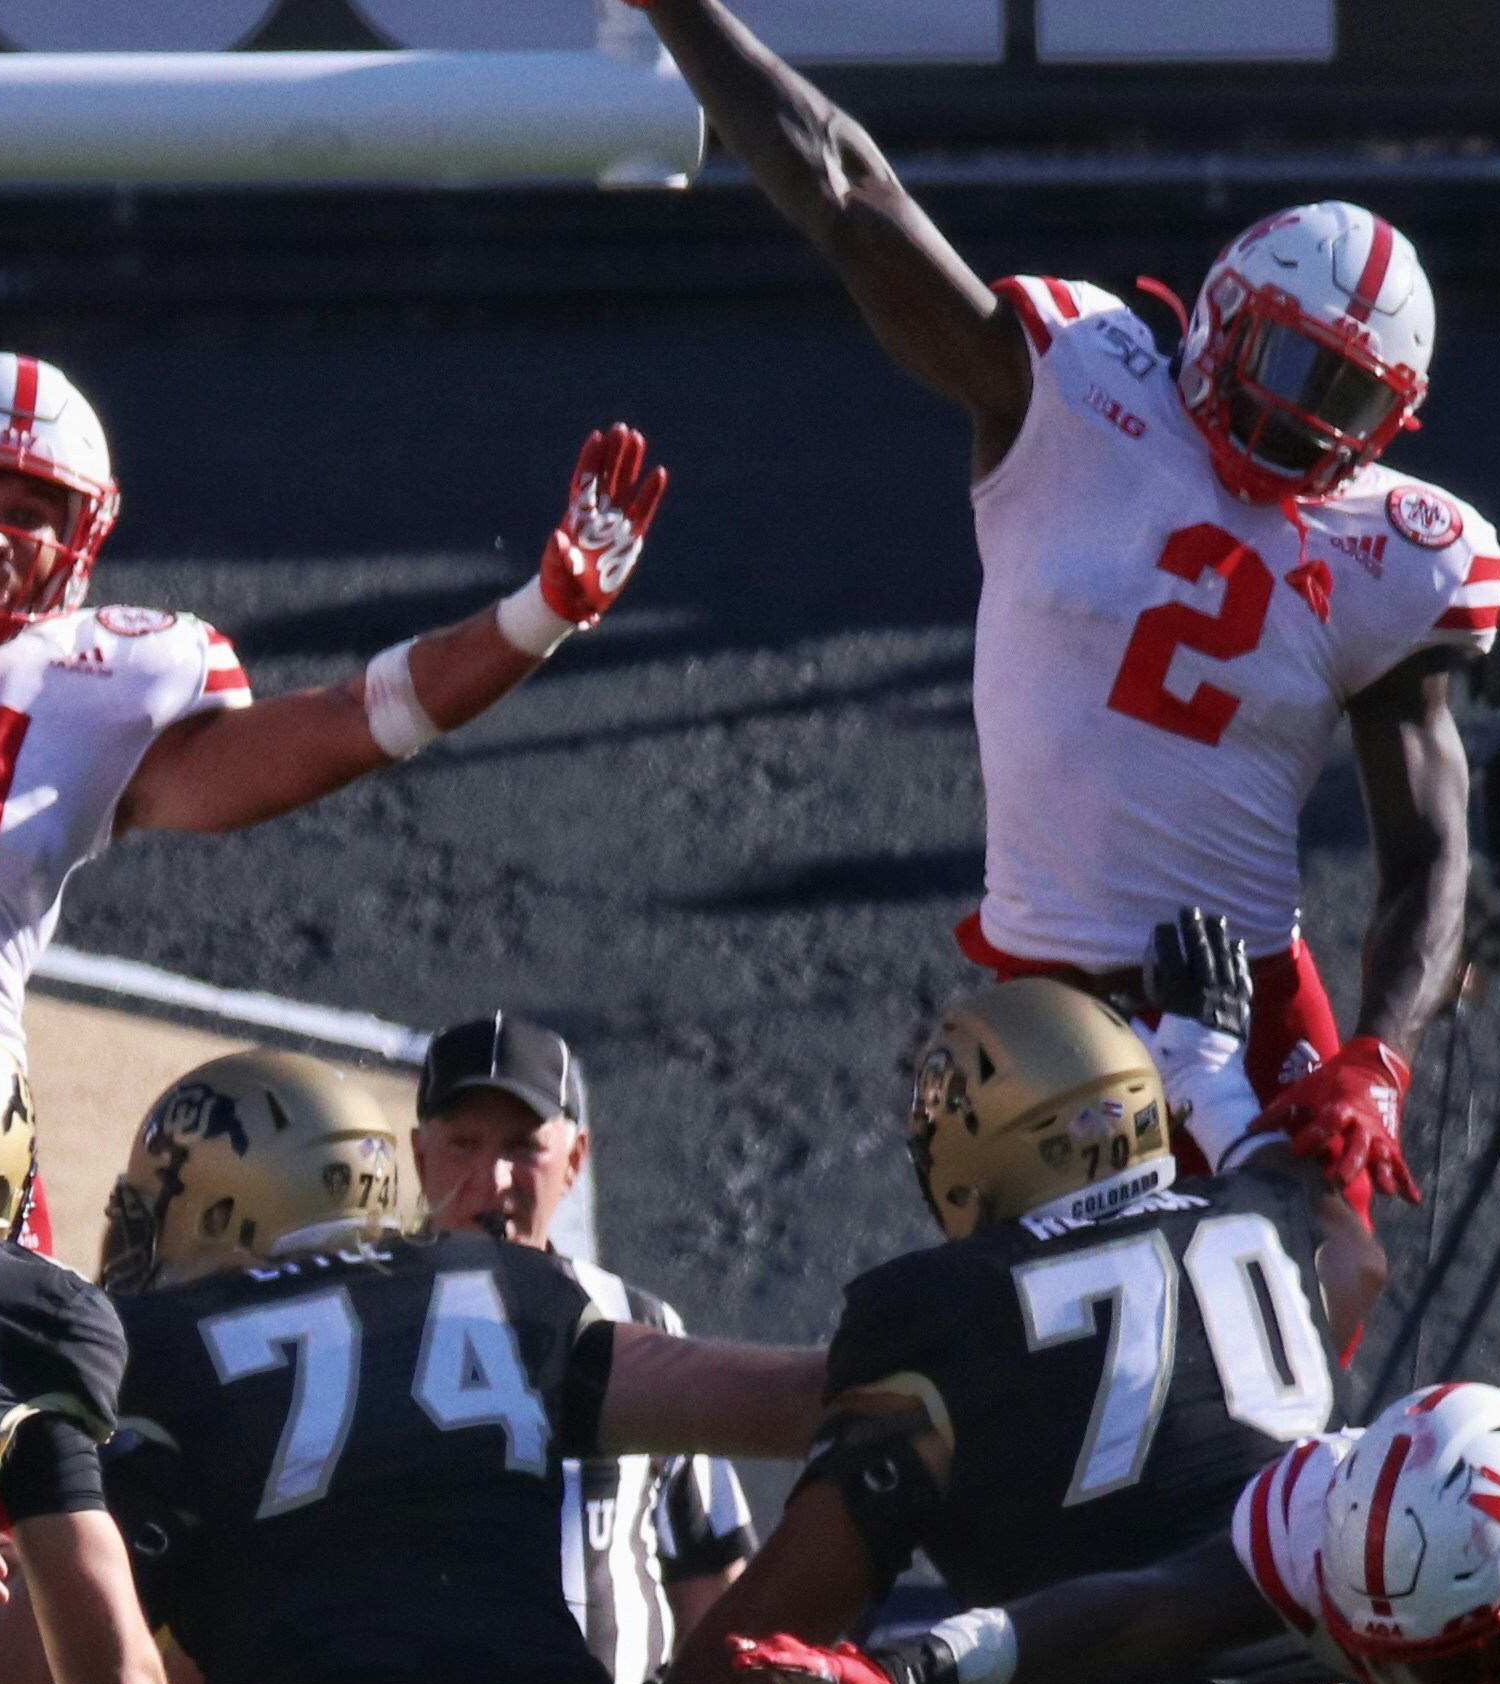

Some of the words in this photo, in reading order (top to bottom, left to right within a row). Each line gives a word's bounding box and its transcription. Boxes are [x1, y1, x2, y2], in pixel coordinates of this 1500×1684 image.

[1106, 521, 1274, 748] 2
[1070, 1169, 1160, 1220] COLORADO
[1081, 1133, 1130, 1182] 70
[197, 1285, 548, 1521] 74
[1009, 1212, 1335, 1508] 70
[586, 1498, 616, 1551] U
